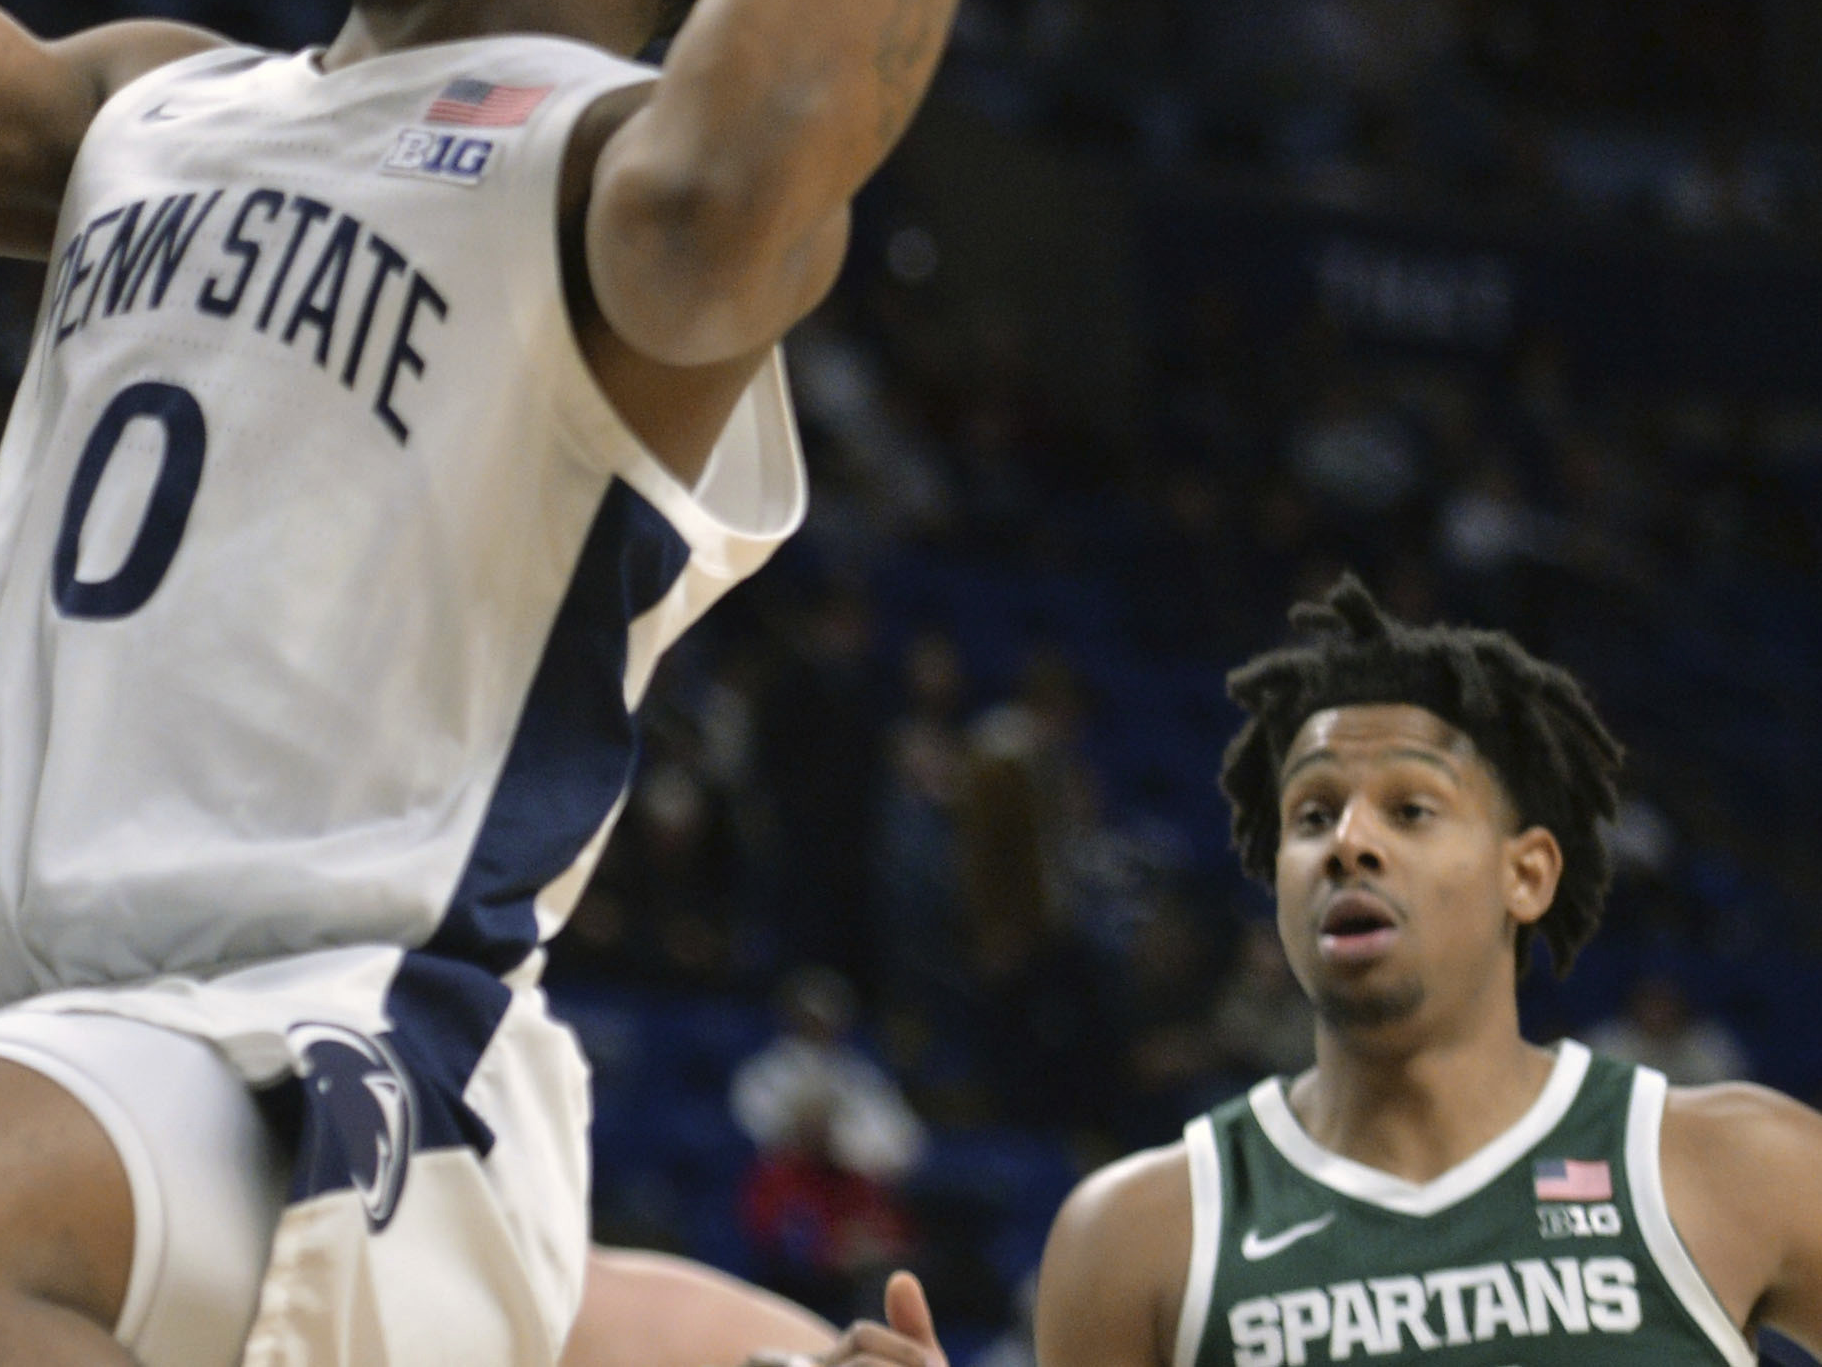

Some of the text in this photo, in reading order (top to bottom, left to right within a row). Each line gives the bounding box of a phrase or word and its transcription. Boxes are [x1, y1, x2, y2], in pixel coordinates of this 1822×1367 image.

[42, 187, 448, 448] PENN STATE
[52, 381, 207, 621] 0
[1227, 1255, 1642, 1367] SPARTANS
